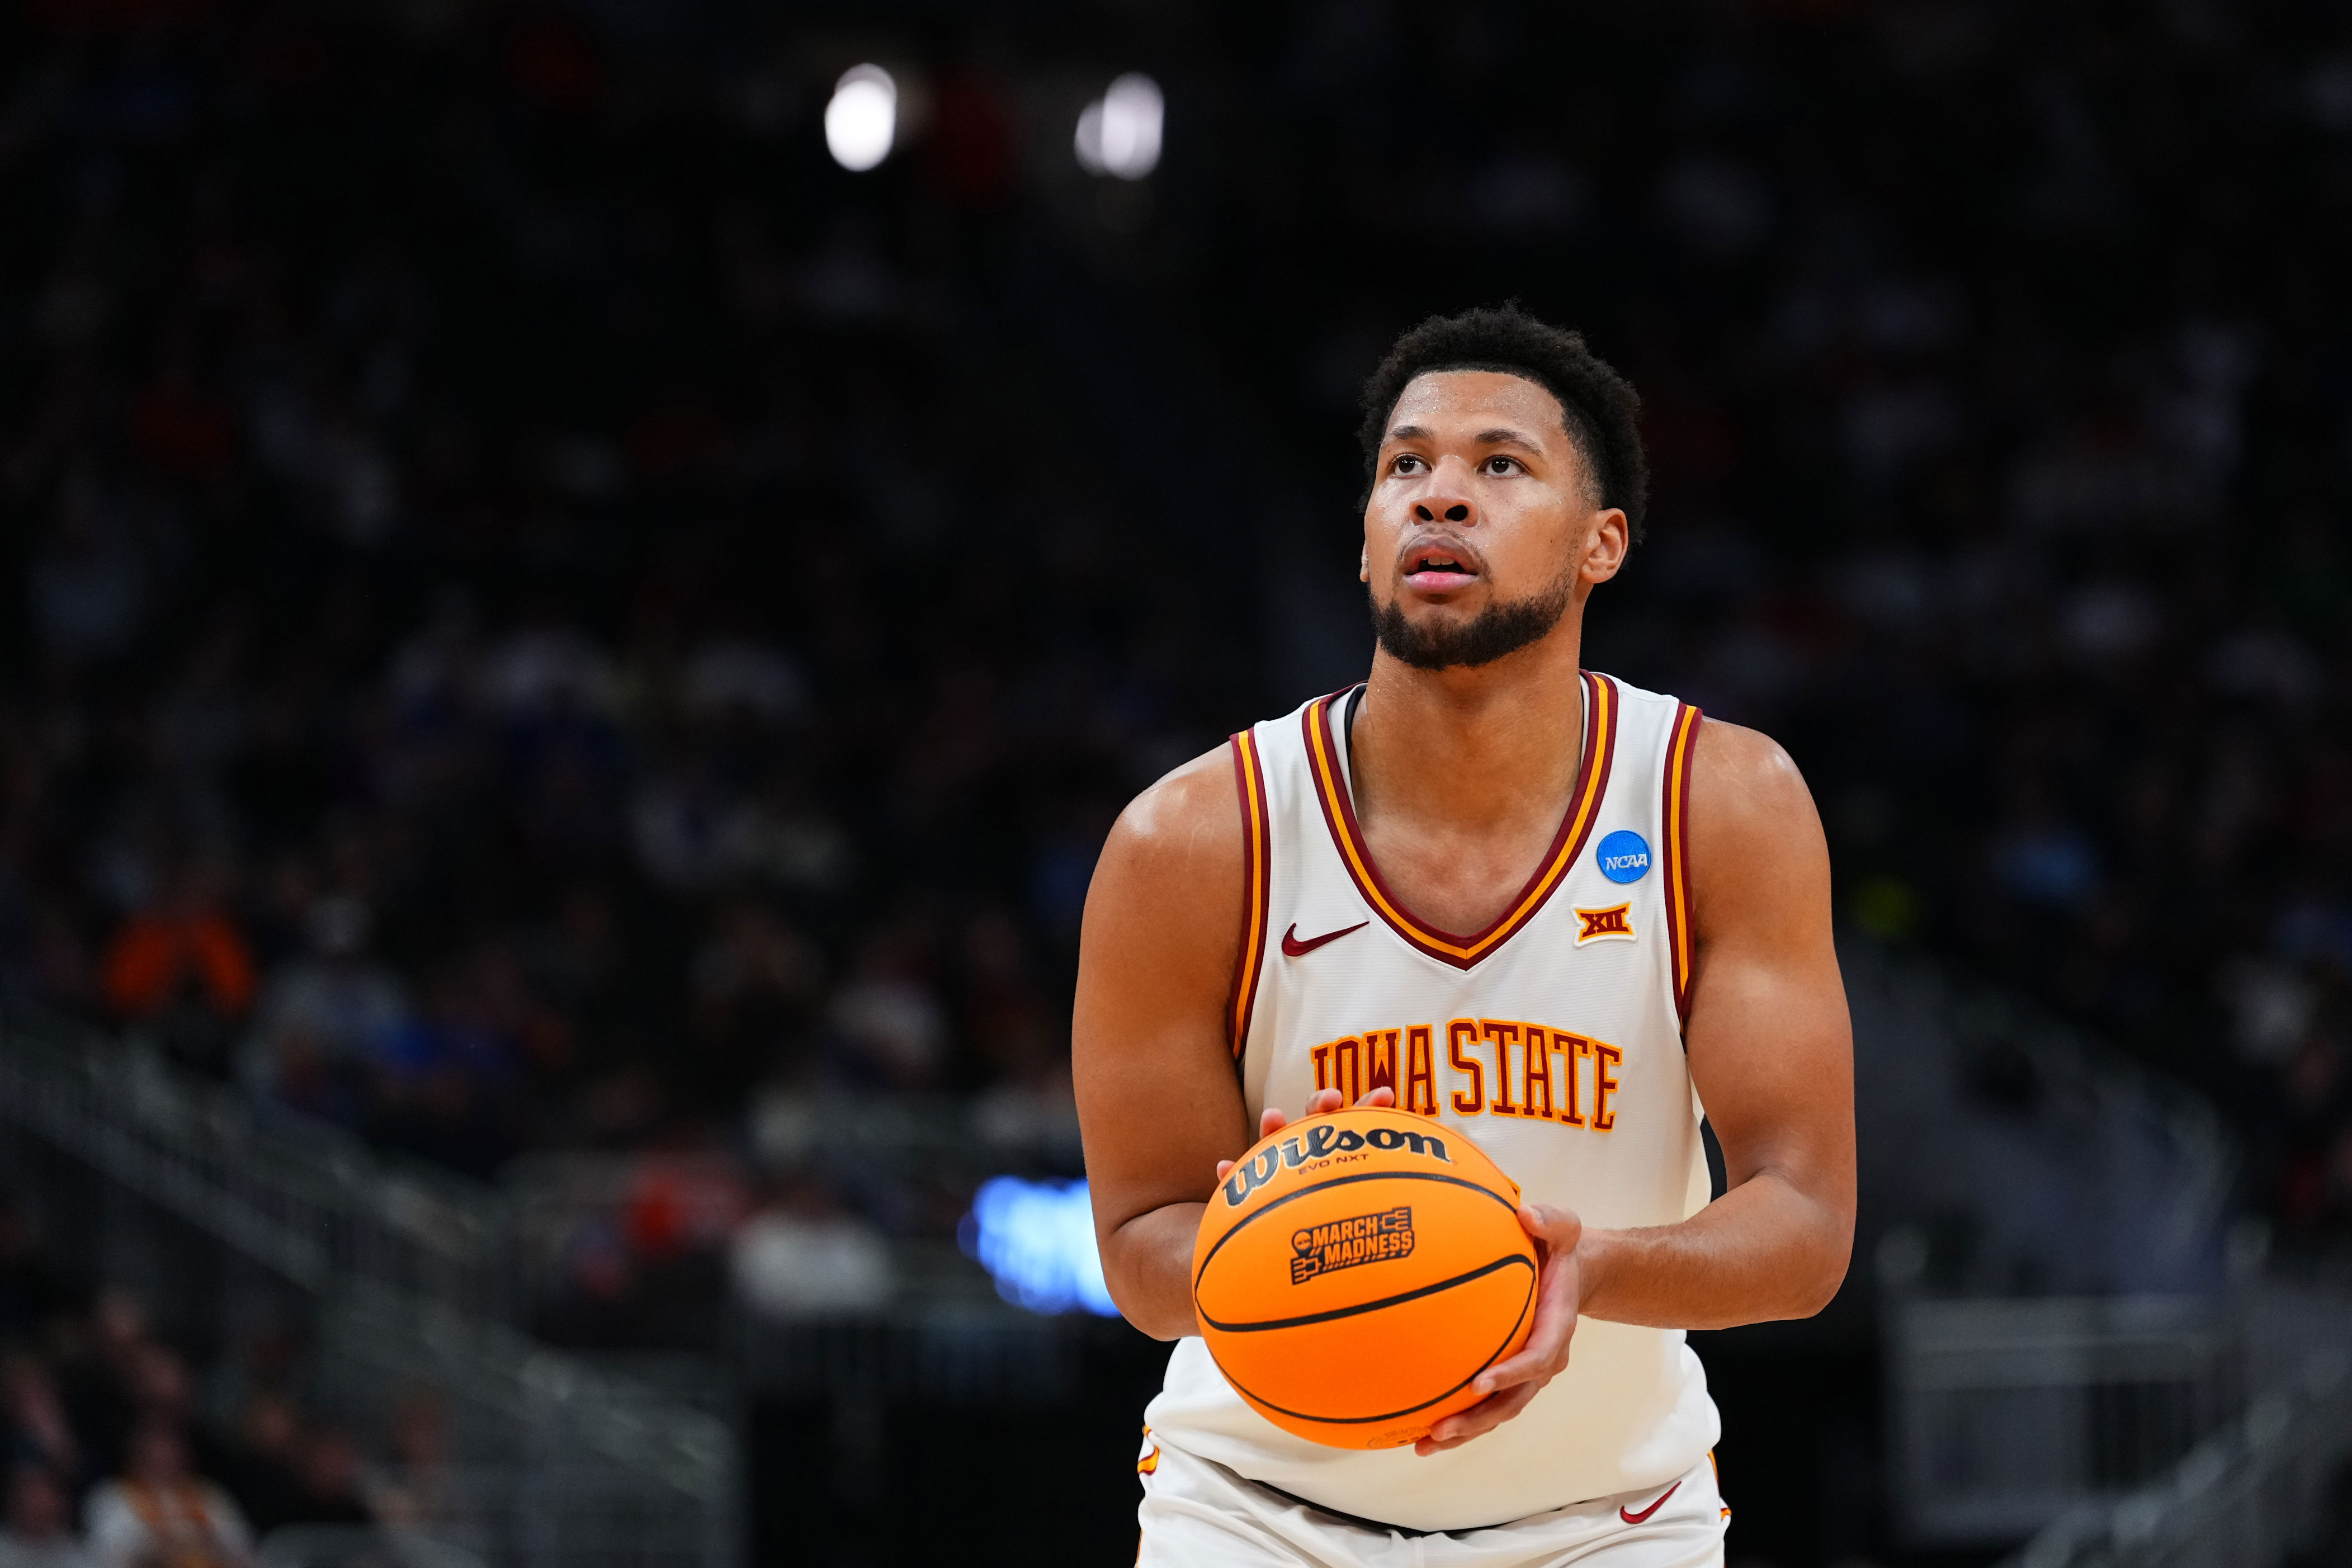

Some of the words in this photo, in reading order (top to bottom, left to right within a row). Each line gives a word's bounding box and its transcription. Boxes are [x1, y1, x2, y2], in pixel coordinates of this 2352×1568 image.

[1605, 853, 1647, 870] NCAA
[1580, 906, 1629, 938] XII
[1311, 1023, 1440, 1117] IOWA
[1447, 1018, 1623, 1132] STATE
[1222, 1125, 1451, 1207] Wilson
[1298, 1160, 1330, 1175] EVO
[1336, 1154, 1369, 1164] NXT
[1312, 1216, 1378, 1247] MARCH
[1324, 1230, 1413, 1266] MADNESS
